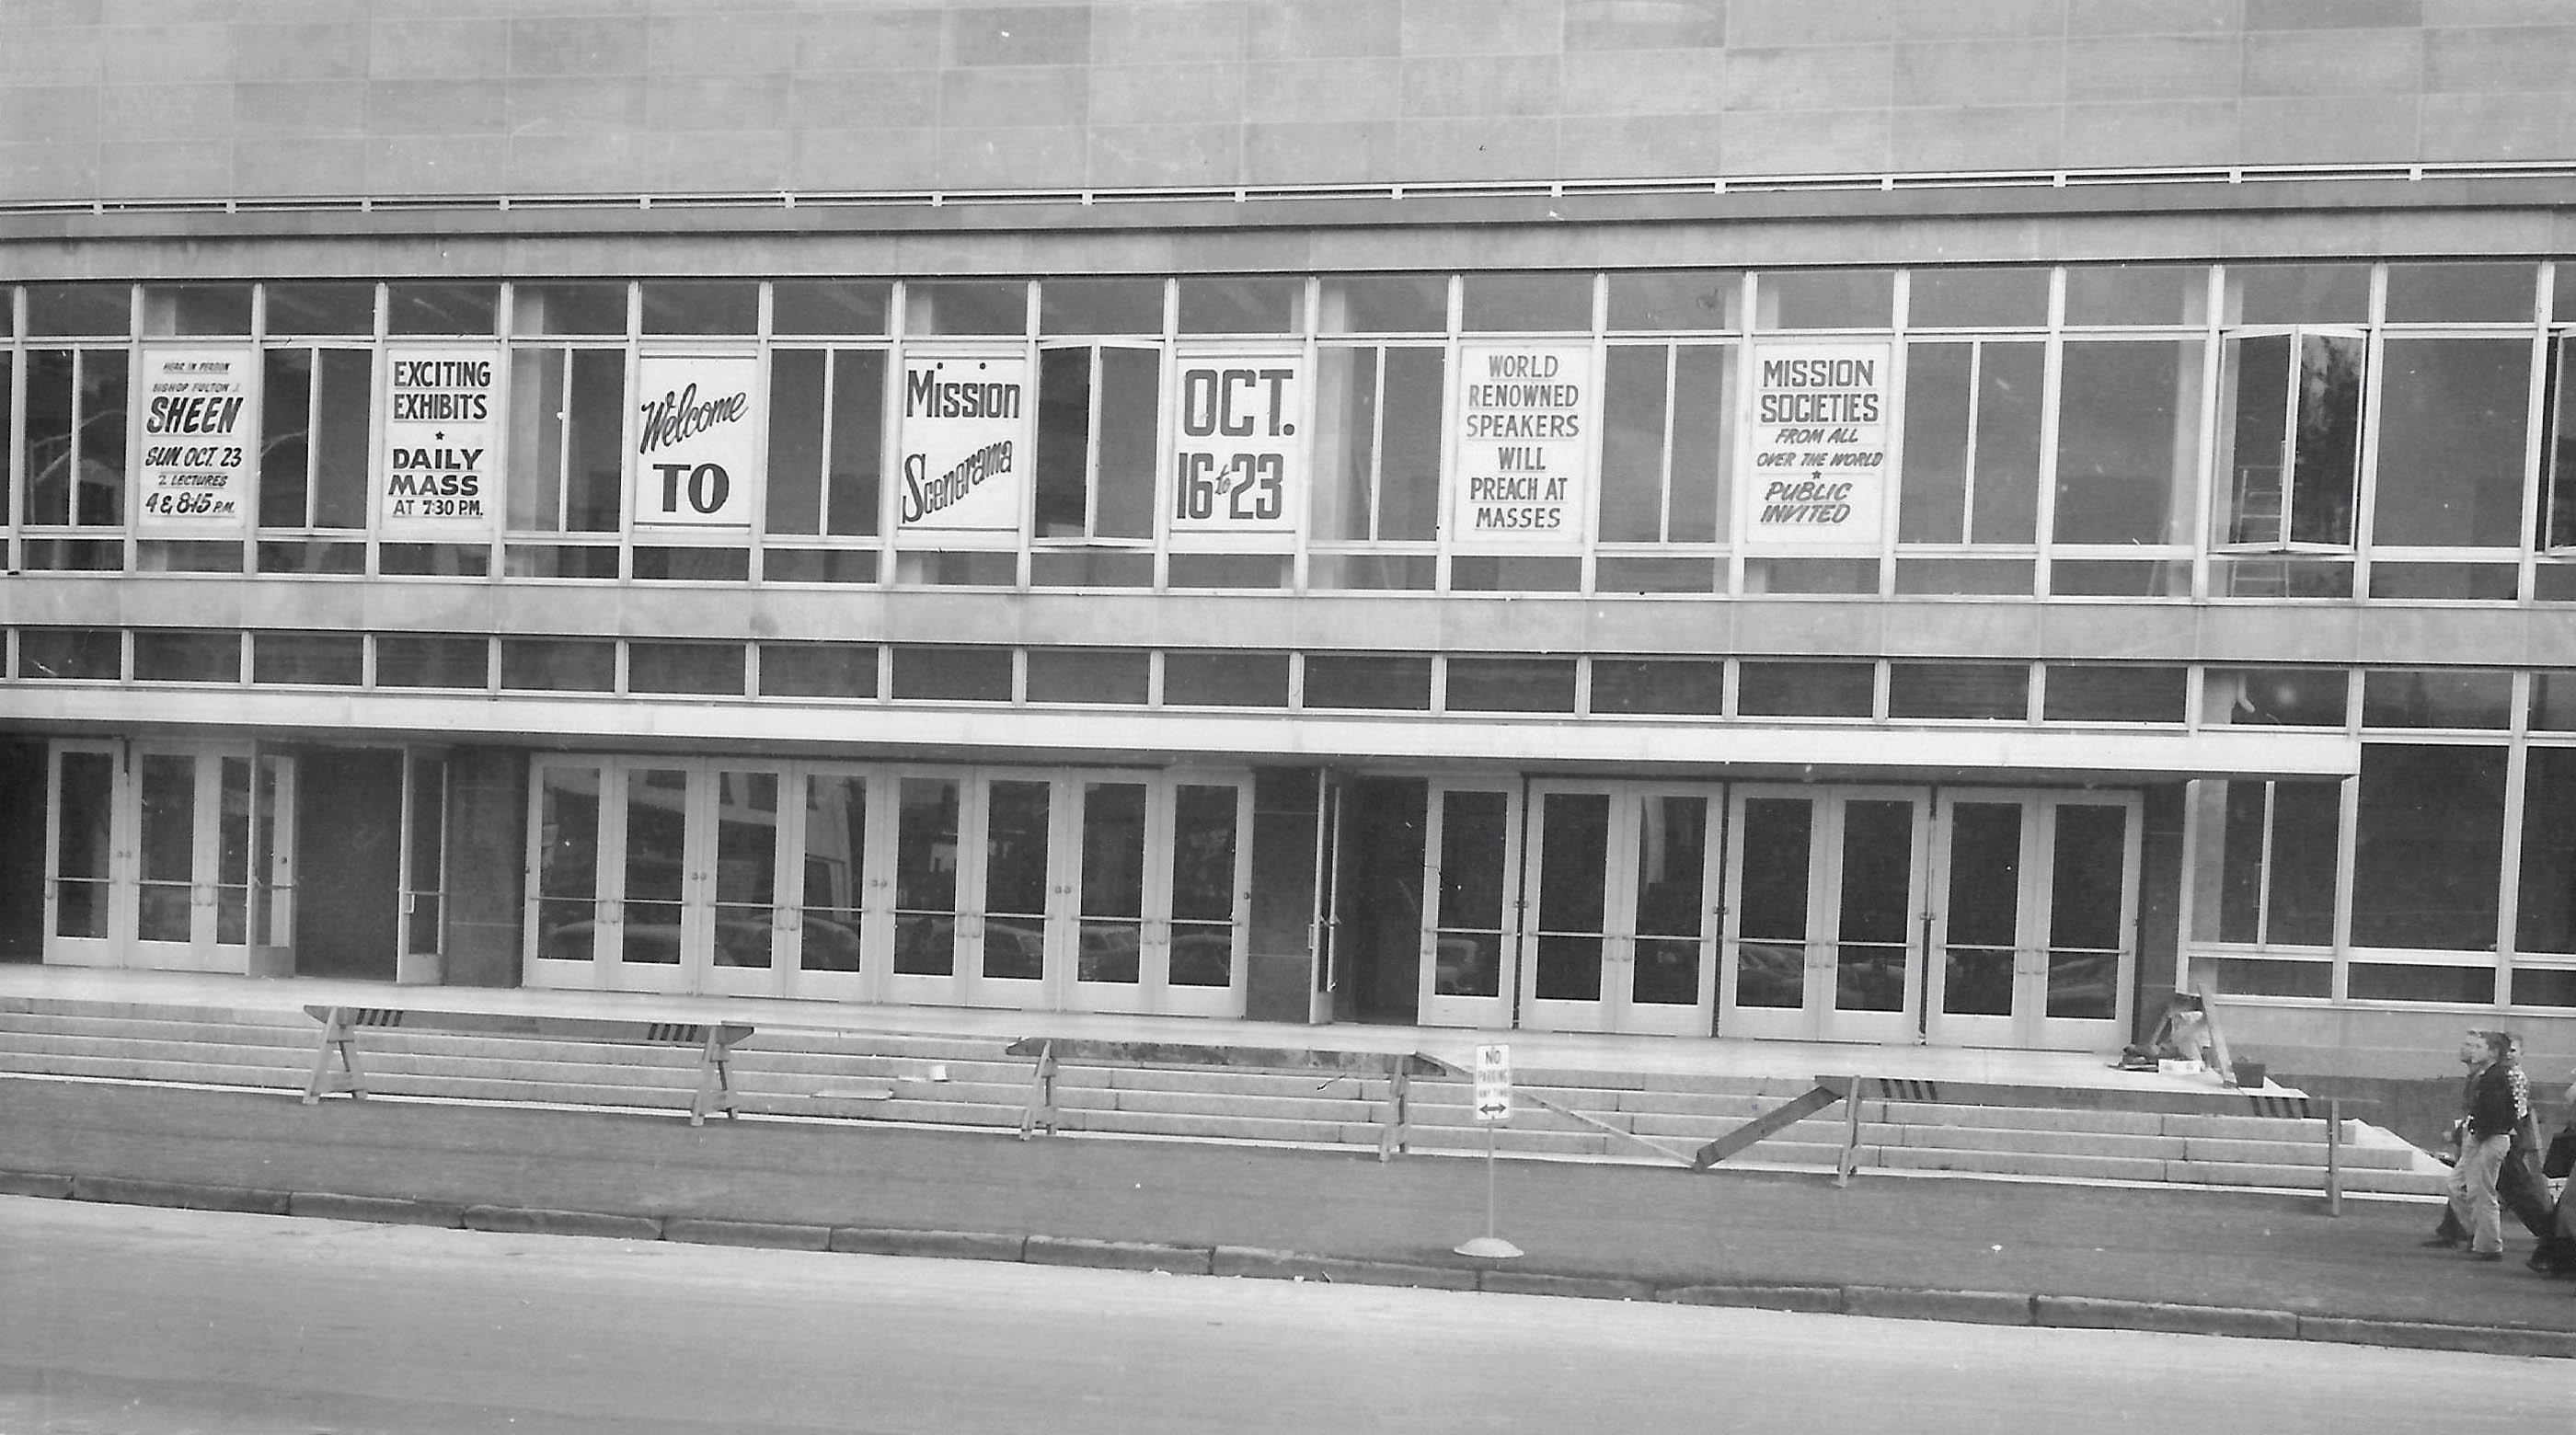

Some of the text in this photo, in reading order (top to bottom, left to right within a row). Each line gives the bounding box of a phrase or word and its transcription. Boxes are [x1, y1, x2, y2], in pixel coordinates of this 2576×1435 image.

[394, 361, 491, 387] EXCITING
[1489, 355, 1558, 378] WORLD
[1764, 360, 1874, 387] MISSION
[906, 362, 1021, 419] Mission
[1468, 385, 1579, 408] RENOWNED
[147, 396, 244, 433] SHEEN
[394, 394, 488, 419] EXHIBITS
[1184, 369, 1294, 437] OCT.
[1761, 393, 1879, 423] SOCIETIES
[640, 383, 749, 454] Welcome
[1466, 414, 1580, 438] SPEAKERS
[1775, 428, 1858, 444] FROM ALL
[184, 447, 219, 467] OCT.
[220, 447, 242, 467] 23
[393, 448, 484, 470] DAILY
[1498, 447, 1546, 471] WILL
[1757, 452, 1883, 467] OVER THE WORLD
[158, 474, 228, 487] 2 LECTURES
[388, 475, 478, 496] MASS
[652, 463, 730, 514] TO
[902, 441, 1012, 524] Scenerama
[1177, 453, 1283, 520] 16 to 23
[1470, 477, 1568, 500] PREACH AT
[1765, 481, 1853, 501] PUBLIC
[145, 492, 159, 512] 4
[394, 499, 415, 514] AT
[422, 499, 454, 515] 7:30
[1760, 503, 1851, 523] INVITED
[1476, 507, 1561, 529] MASSES
[1485, 1050, 1501, 1064] NO
